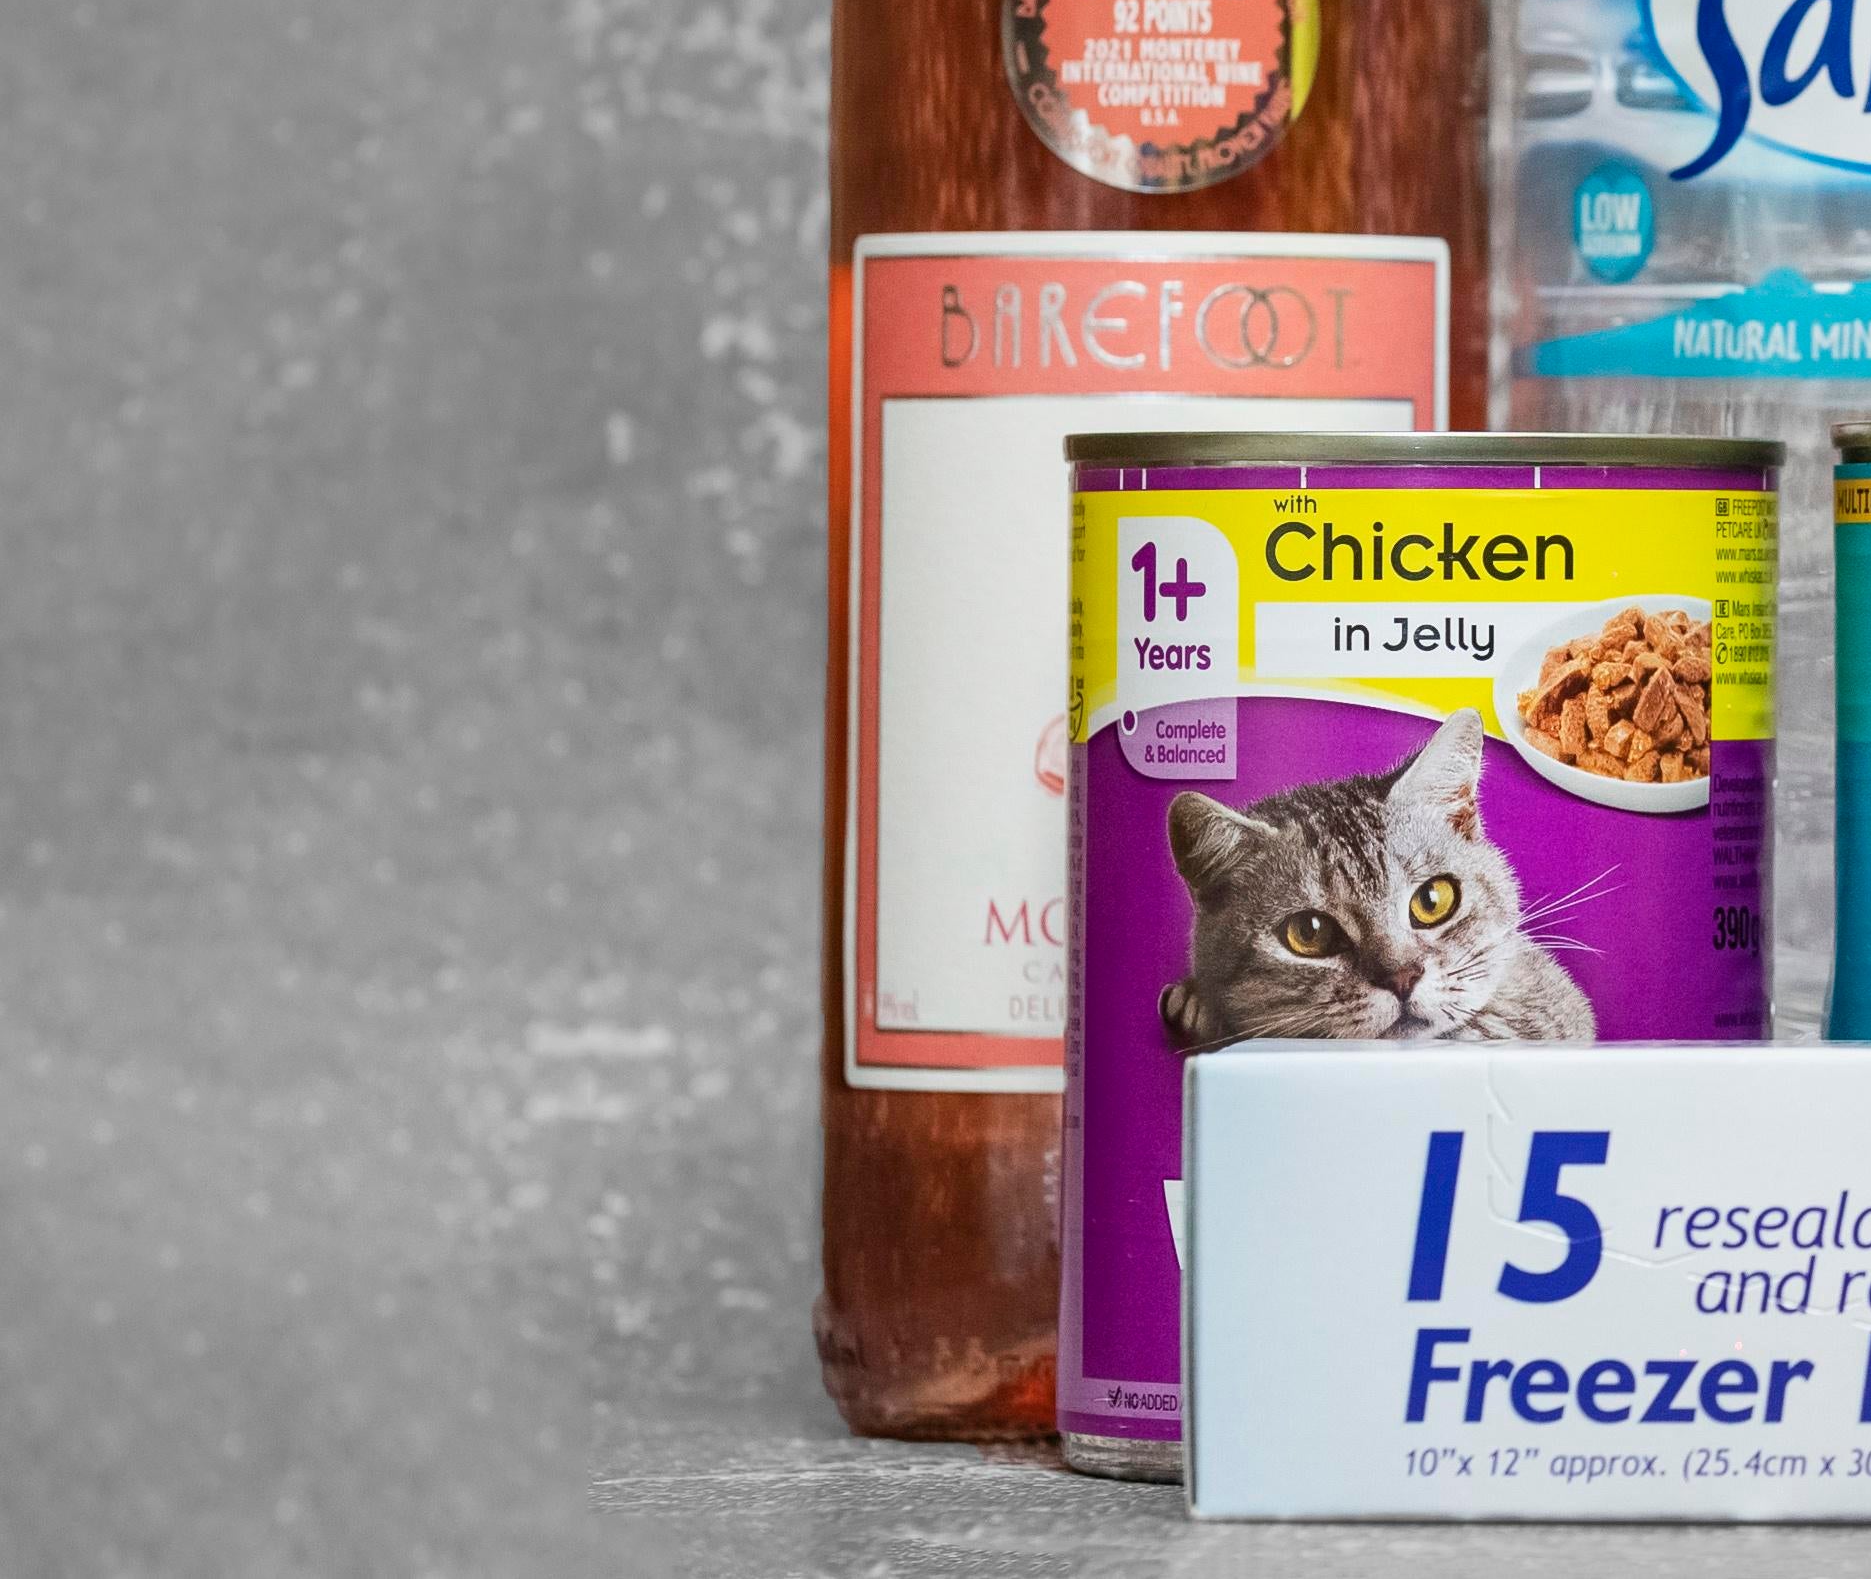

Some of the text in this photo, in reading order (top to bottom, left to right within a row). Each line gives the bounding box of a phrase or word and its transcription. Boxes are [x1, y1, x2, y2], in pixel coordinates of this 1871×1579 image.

[1084, 39, 1241, 62] 2021 MONTEREY
[1061, 60, 1263, 86] INTERNATIONAL WINE
[1097, 85, 1227, 108] COMPETITION
[1581, 192, 1641, 231] LOW
[940, 279, 1354, 372] BAREFOOT
[1673, 319, 1802, 361] NATURAL
[1273, 495, 1317, 514] with
[1716, 522, 1753, 539] PETCARE
[1264, 521, 1575, 583] Chicken
[1131, 541, 1207, 622] 1+
[1732, 600, 1750, 617] Mars
[1133, 636, 1212, 671] Years
[1333, 615, 1496, 662] in Jelly
[1155, 719, 1226, 742] Complete
[1144, 744, 1226, 764] & Balanced
[1712, 906, 1760, 958] 390g
[1404, 1130, 1611, 1304] 15
[1694, 1258, 1817, 1316] and
[1403, 1326, 1814, 1424] Freezer
[1140, 1393, 1177, 1412] ADDED
[1549, 1449, 1668, 1486] approx.
[1682, 1447, 1808, 1486] (25.4cm
[1818, 1456, 1838, 1480] x
